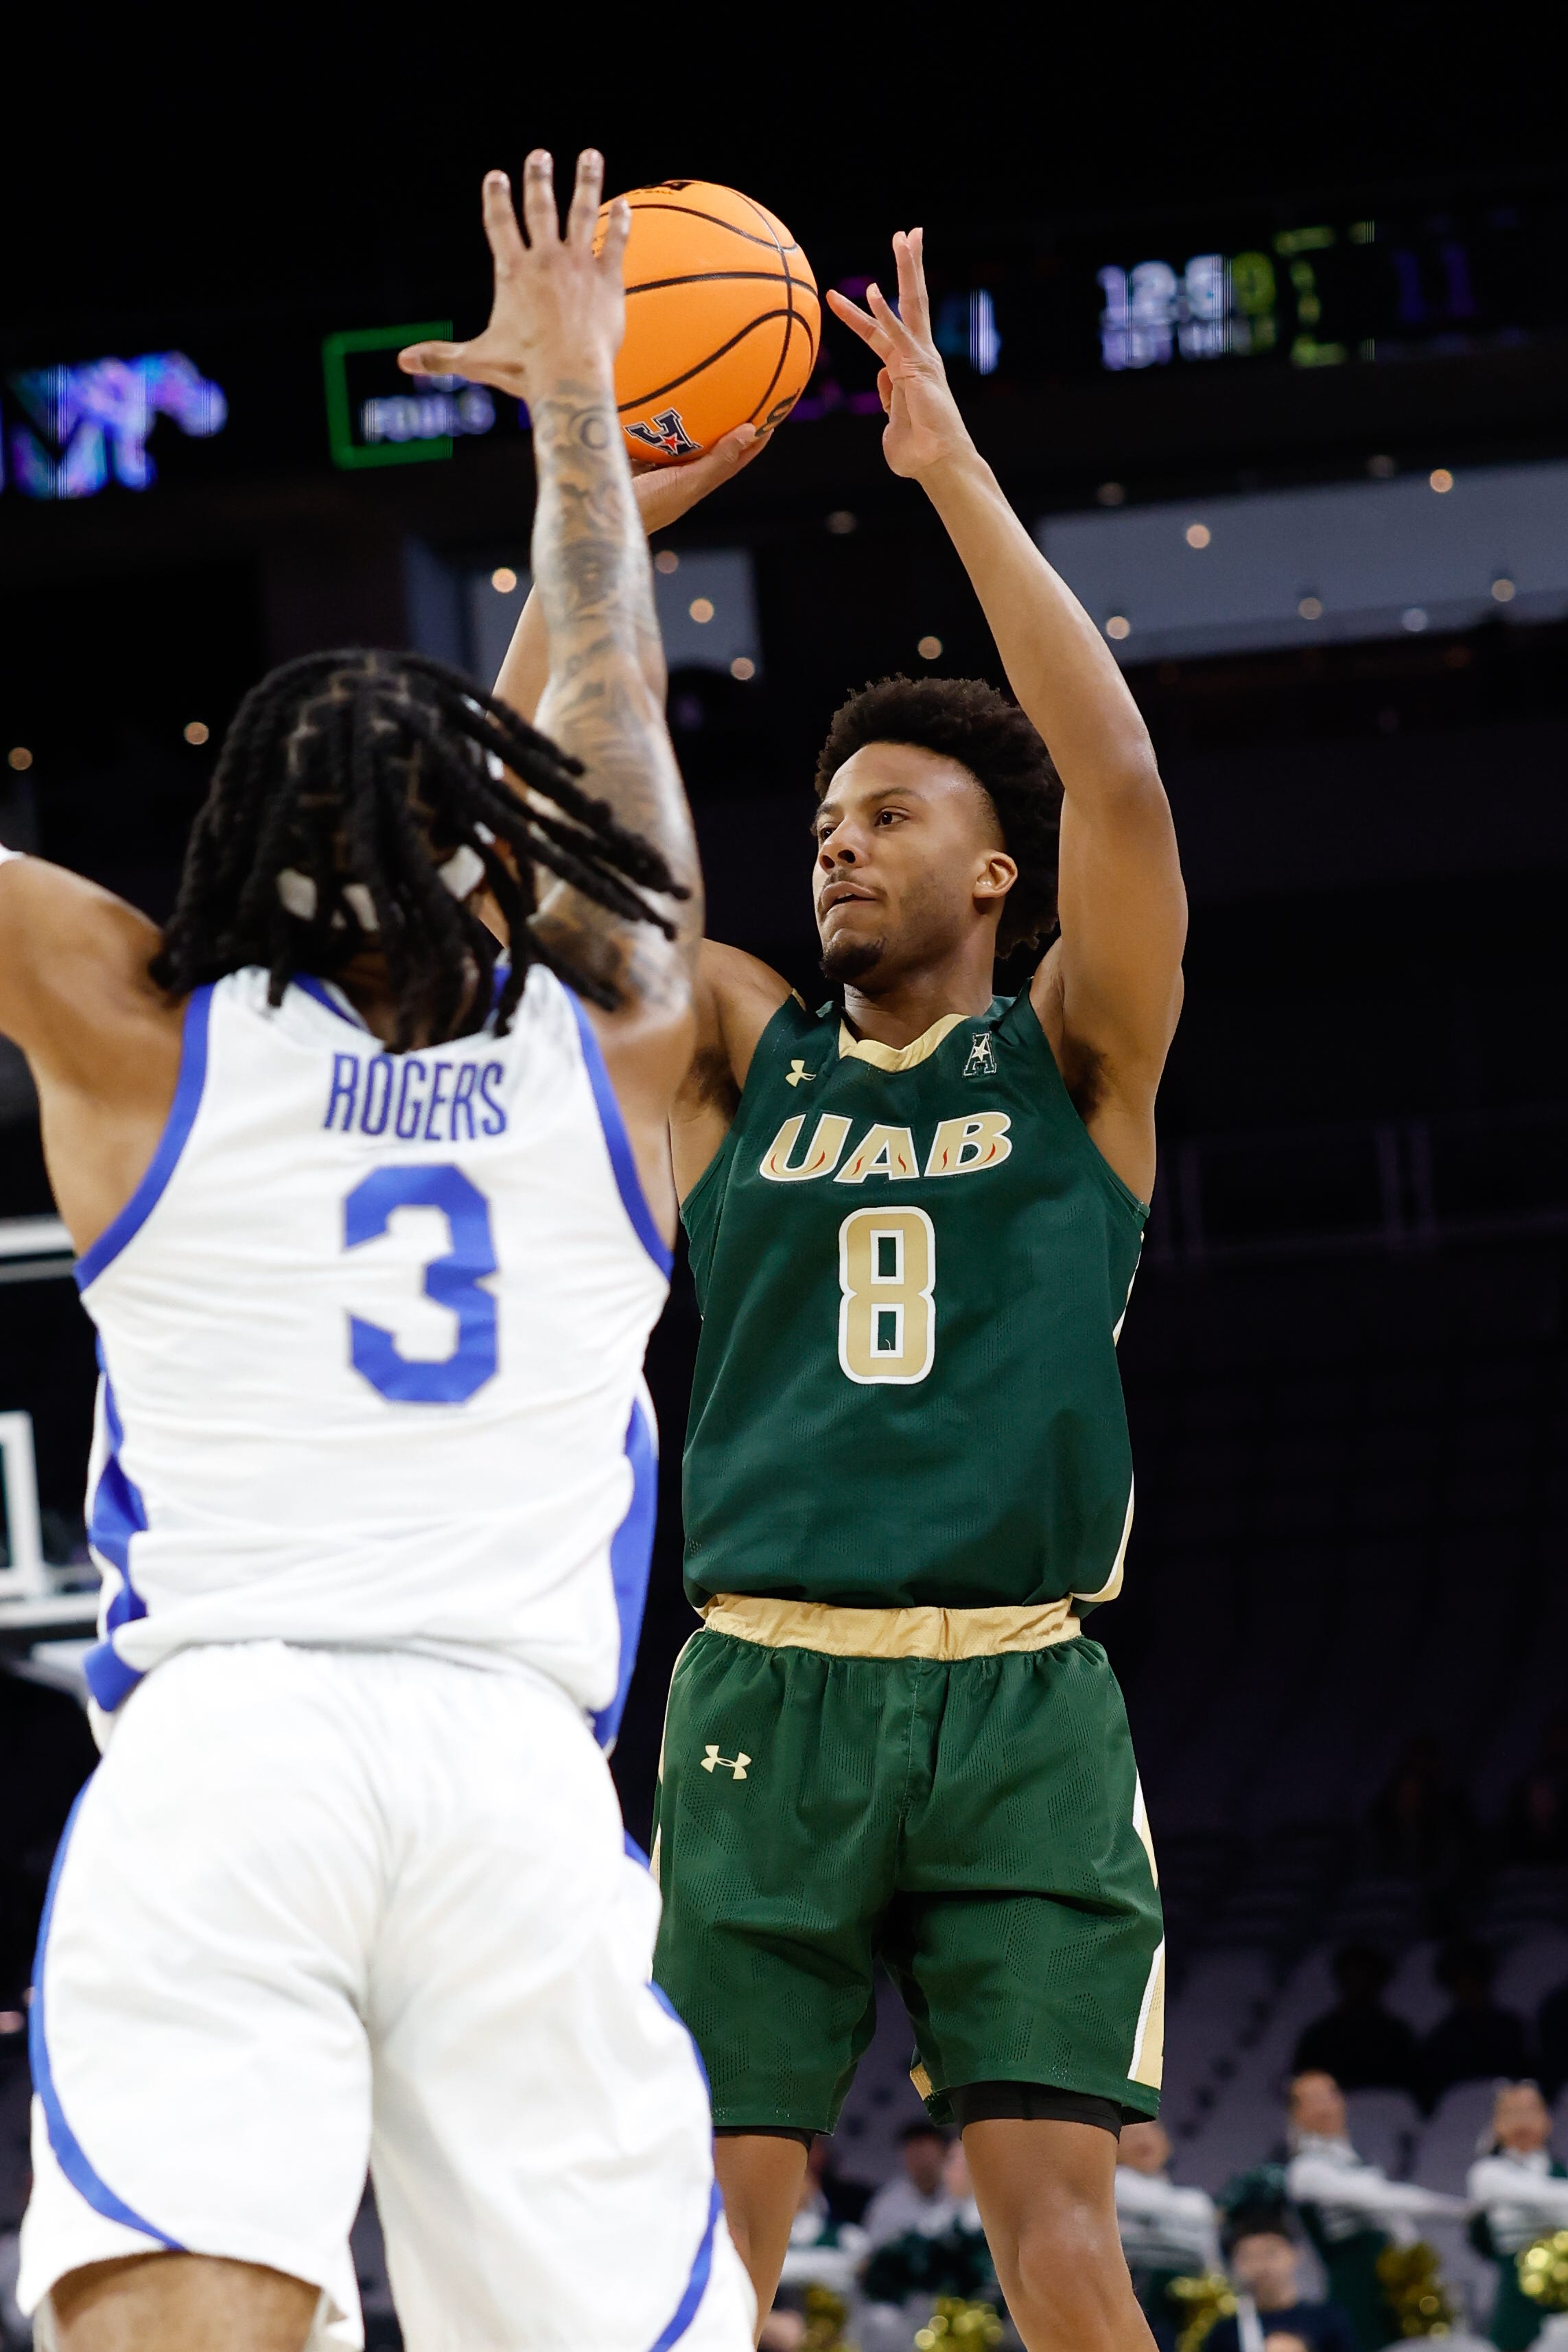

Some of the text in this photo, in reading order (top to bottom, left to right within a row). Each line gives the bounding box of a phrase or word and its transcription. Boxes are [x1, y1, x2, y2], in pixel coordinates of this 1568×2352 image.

[324, 1050, 508, 1142] ROGERS
[758, 1110, 1014, 1185] UAB
[340, 1162, 501, 1406] 3
[838, 1205, 937, 1386] 8
